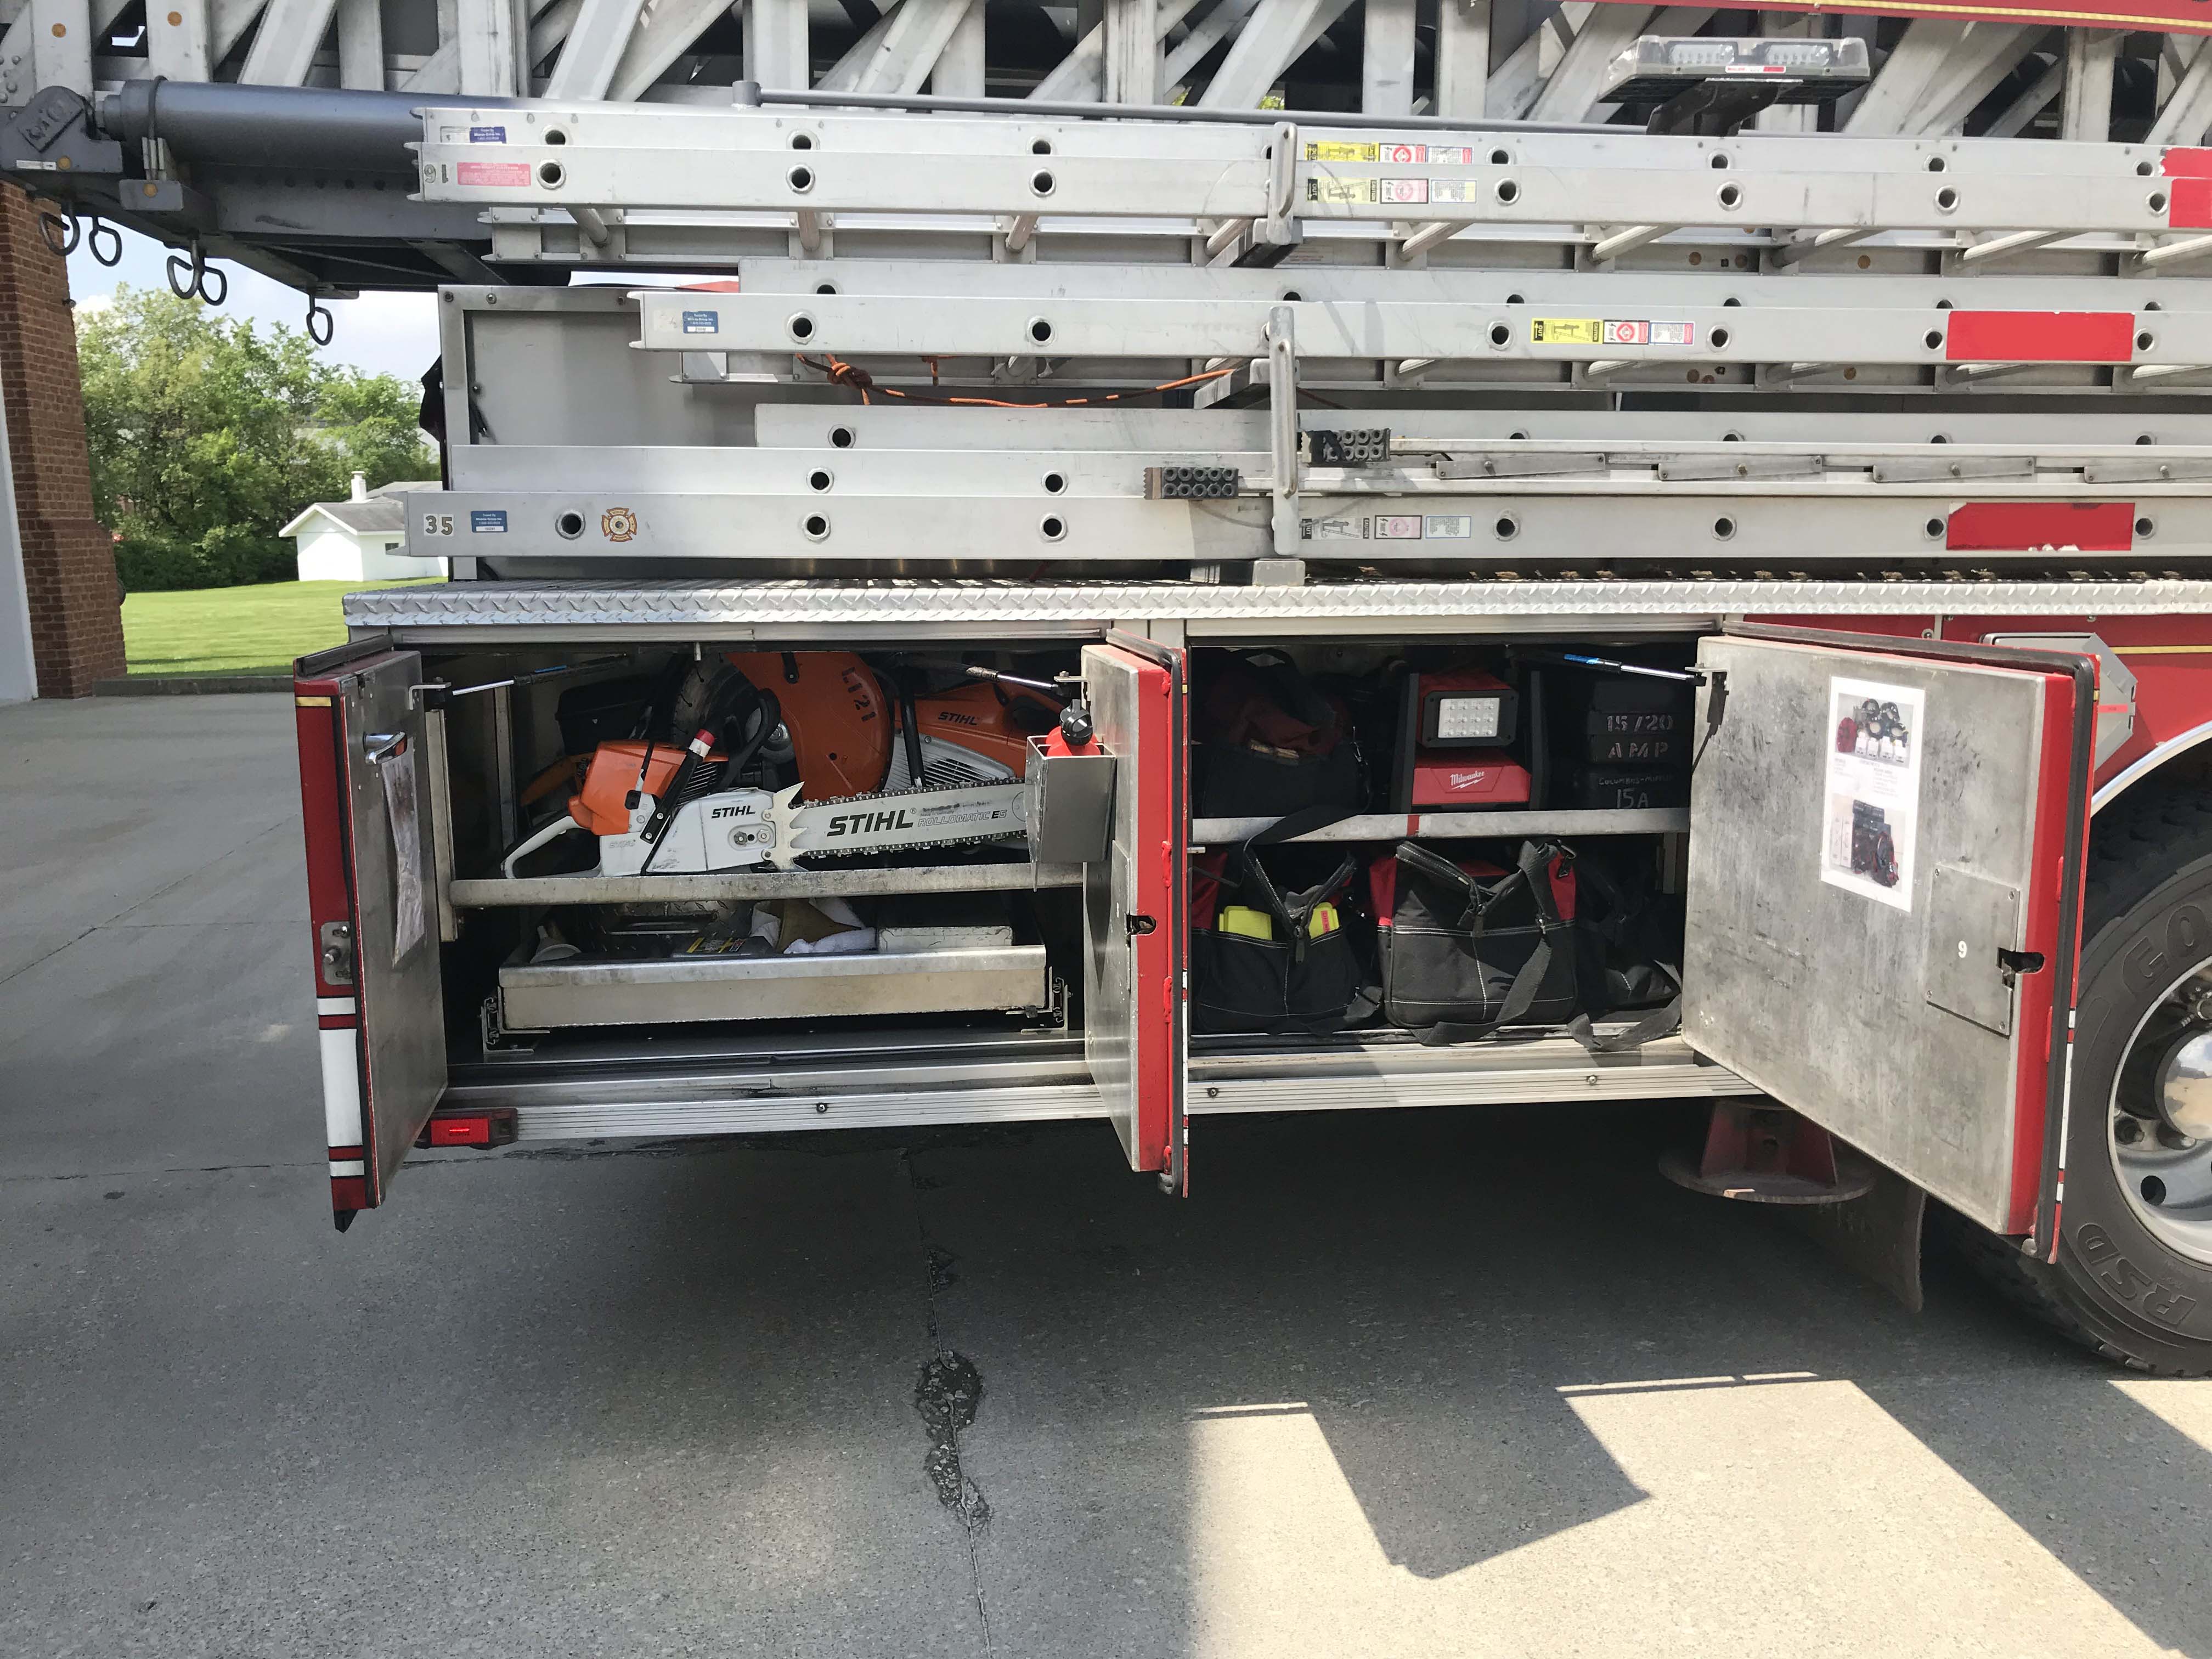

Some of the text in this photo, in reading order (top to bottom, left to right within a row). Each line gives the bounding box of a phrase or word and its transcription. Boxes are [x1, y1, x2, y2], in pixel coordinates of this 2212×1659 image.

[425, 515, 453, 535] 35
[938, 711, 977, 725] STIHL
[1608, 742, 1668, 758] AMP
[1449, 770, 1485, 786] Milwaukee
[712, 805, 755, 819] STIHL
[917, 811, 990, 827] ROLLOMATIC
[991, 809, 1008, 820] ES
[827, 809, 914, 837] STIHL
[1958, 940, 1967, 958] 9
[2076, 1223, 2197, 1325] RSD
